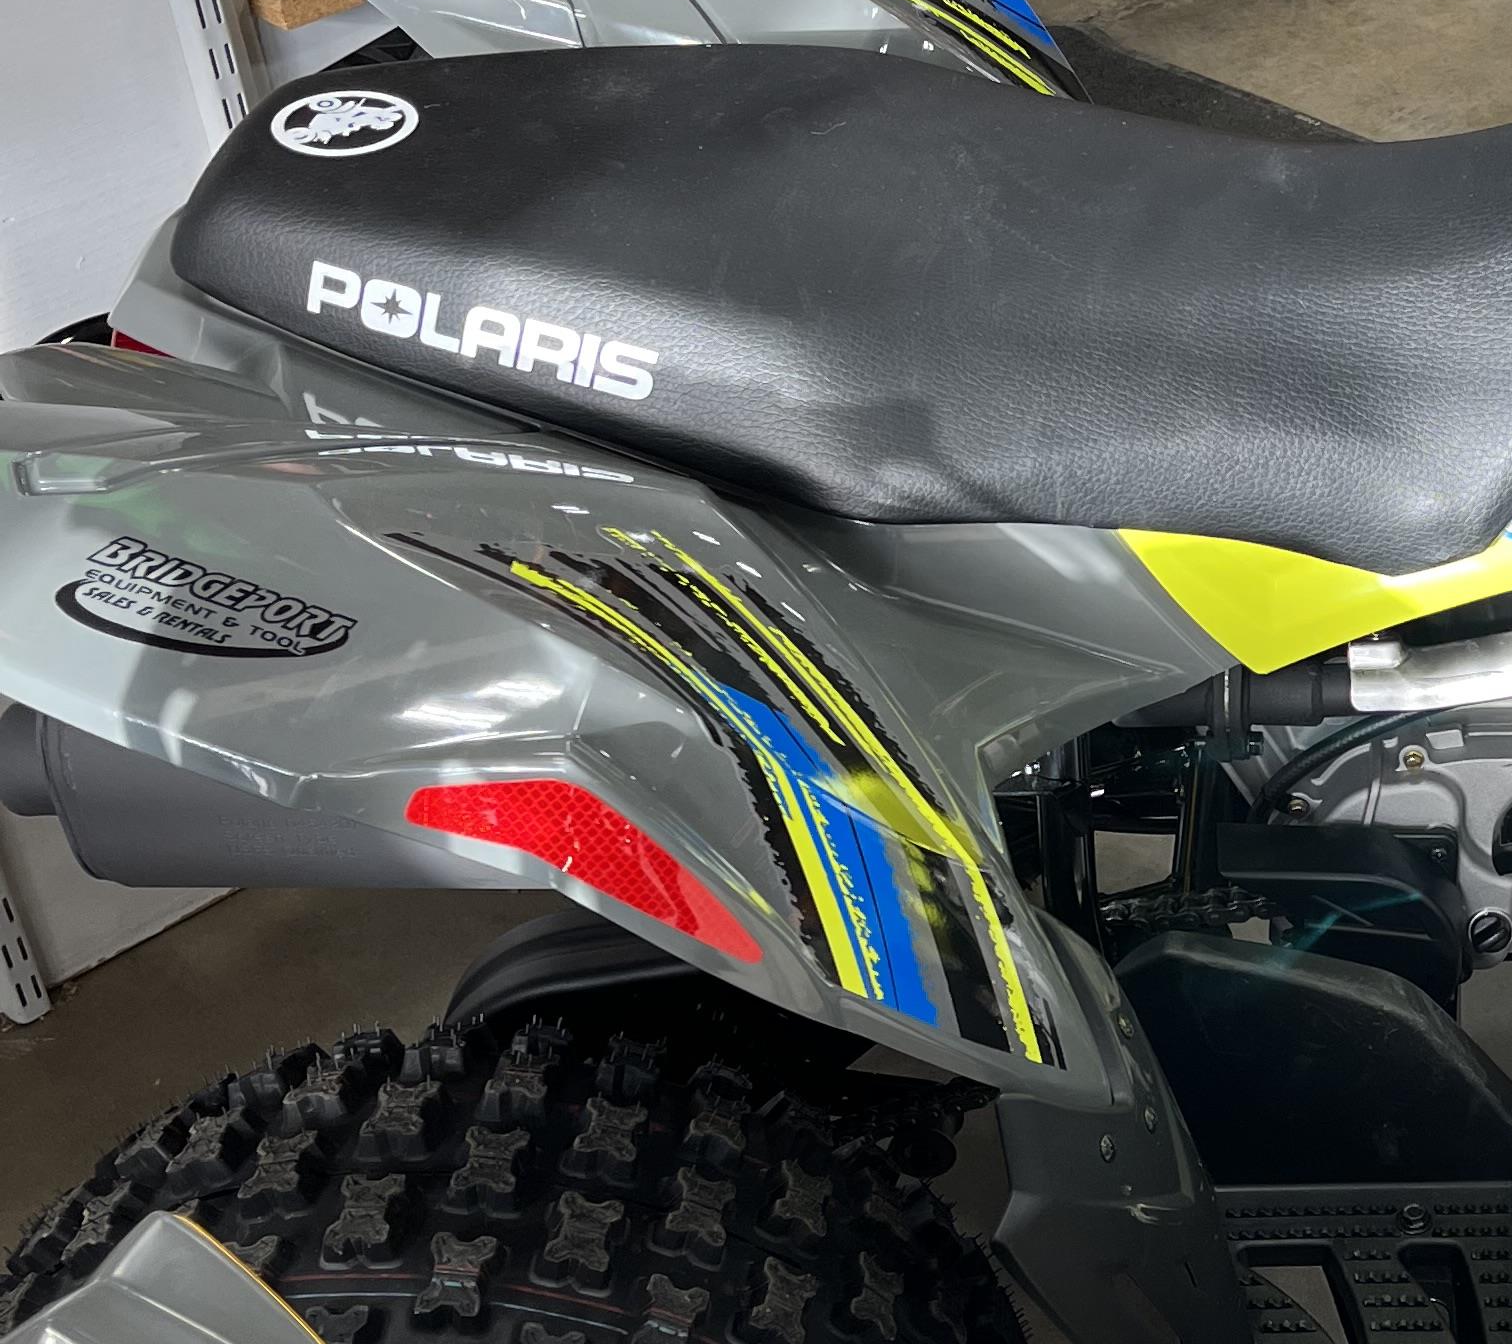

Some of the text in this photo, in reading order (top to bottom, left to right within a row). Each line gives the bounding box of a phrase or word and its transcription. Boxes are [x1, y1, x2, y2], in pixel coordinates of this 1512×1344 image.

[306, 260, 660, 401] POLARIS
[82, 587, 231, 644] SALES & RENTALS
[85, 568, 306, 655] EQUIPMENT & TOOL
[86, 536, 358, 641] BRIDGEPORT
